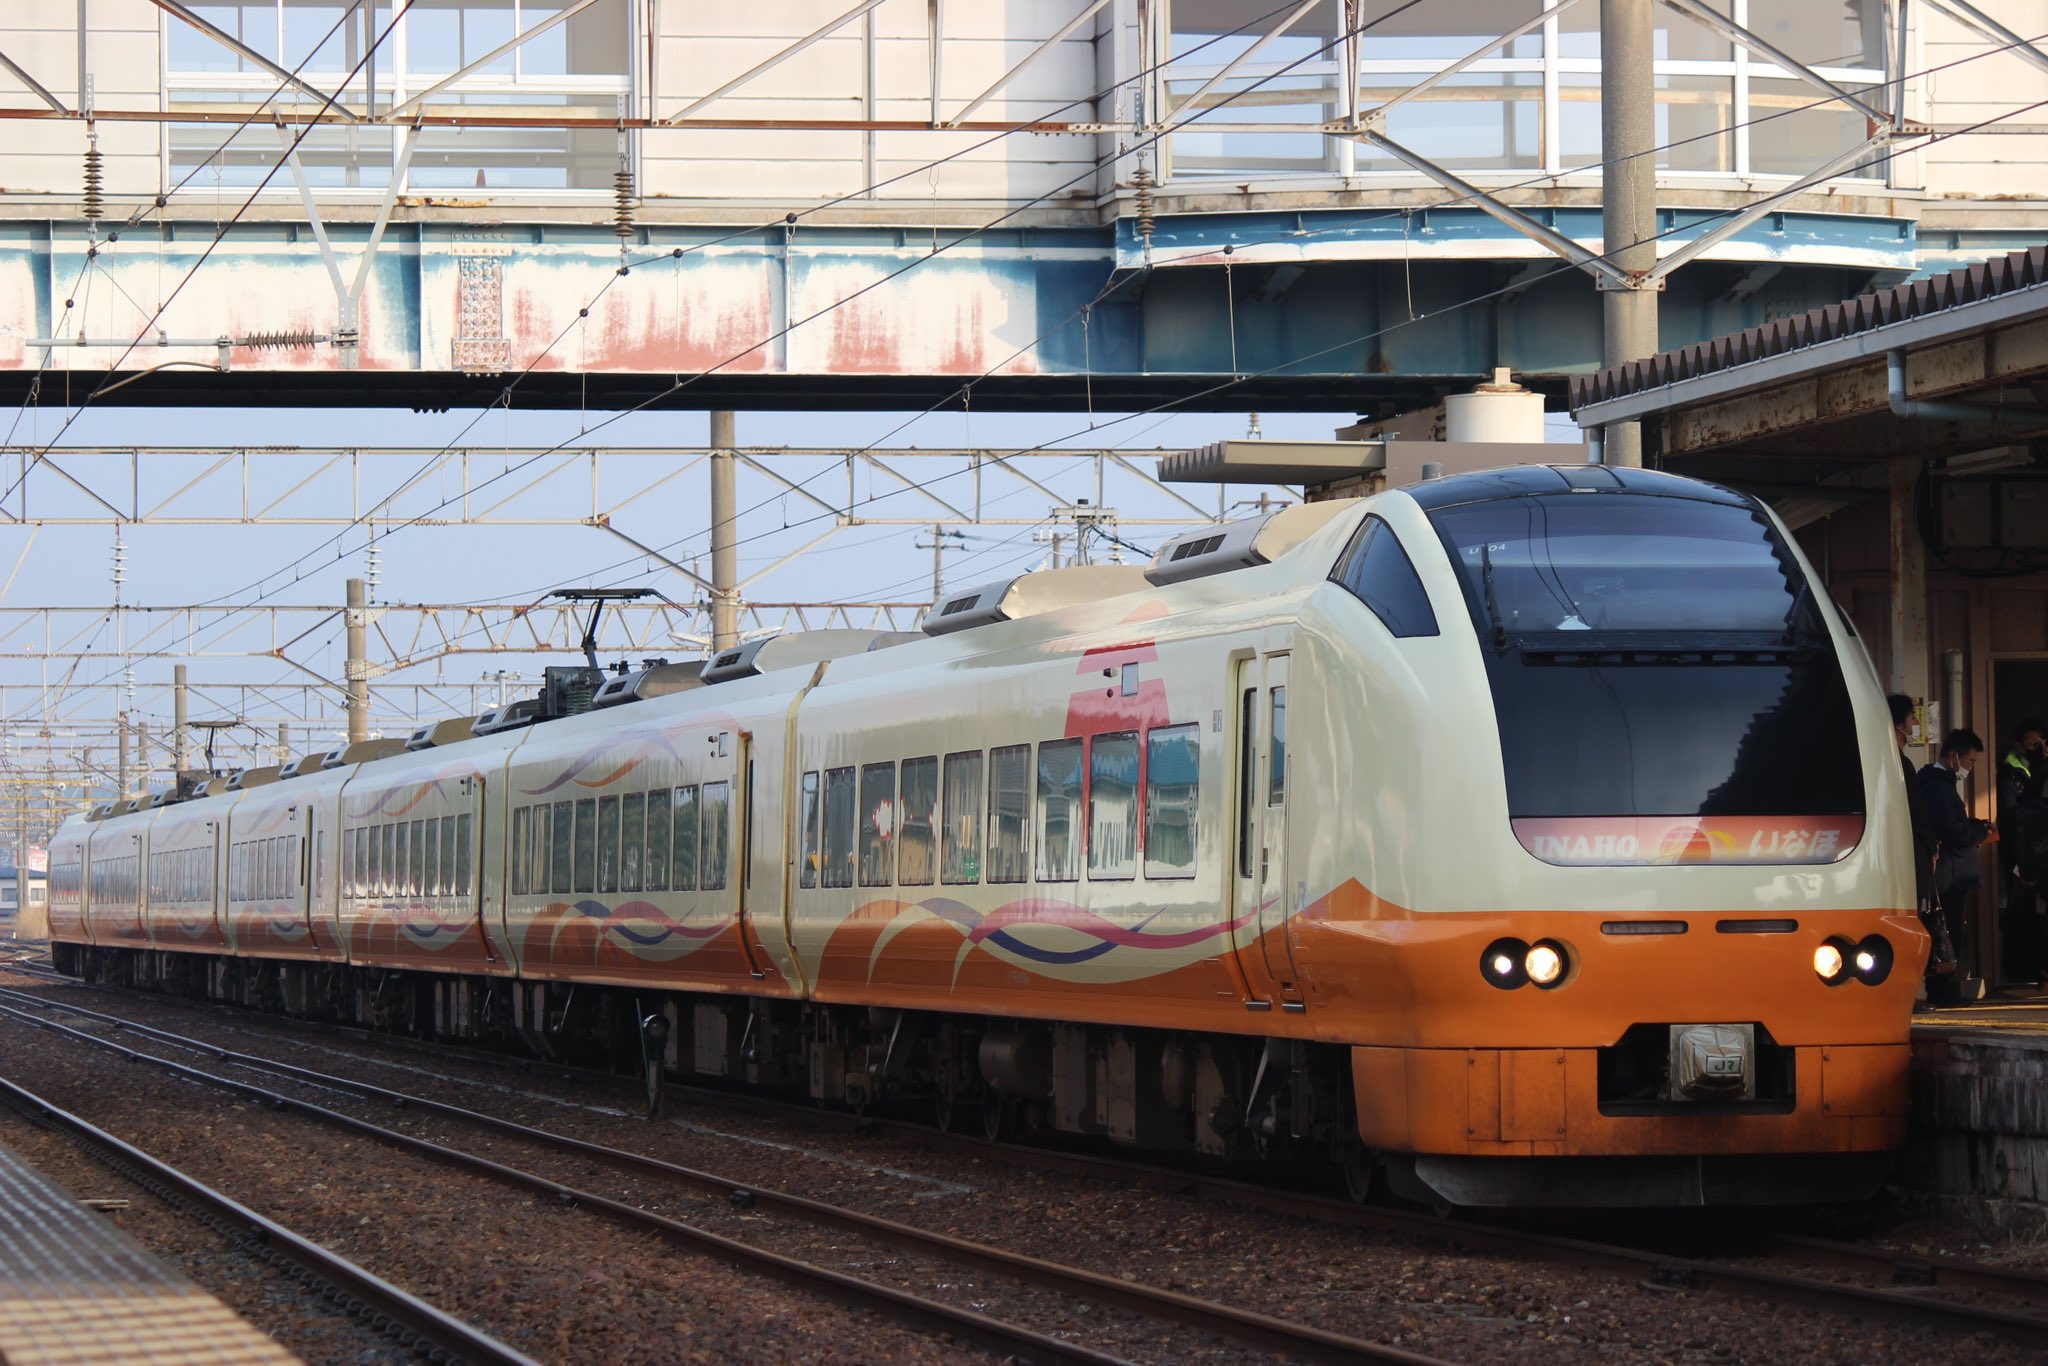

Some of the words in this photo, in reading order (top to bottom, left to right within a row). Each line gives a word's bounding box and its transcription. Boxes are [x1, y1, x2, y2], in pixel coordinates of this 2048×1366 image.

[1469, 543, 1506, 555] U04
[1533, 835, 1638, 859] INAHO
[1749, 829, 1840, 858] いなほ
[1714, 1060, 1734, 1071] JR
